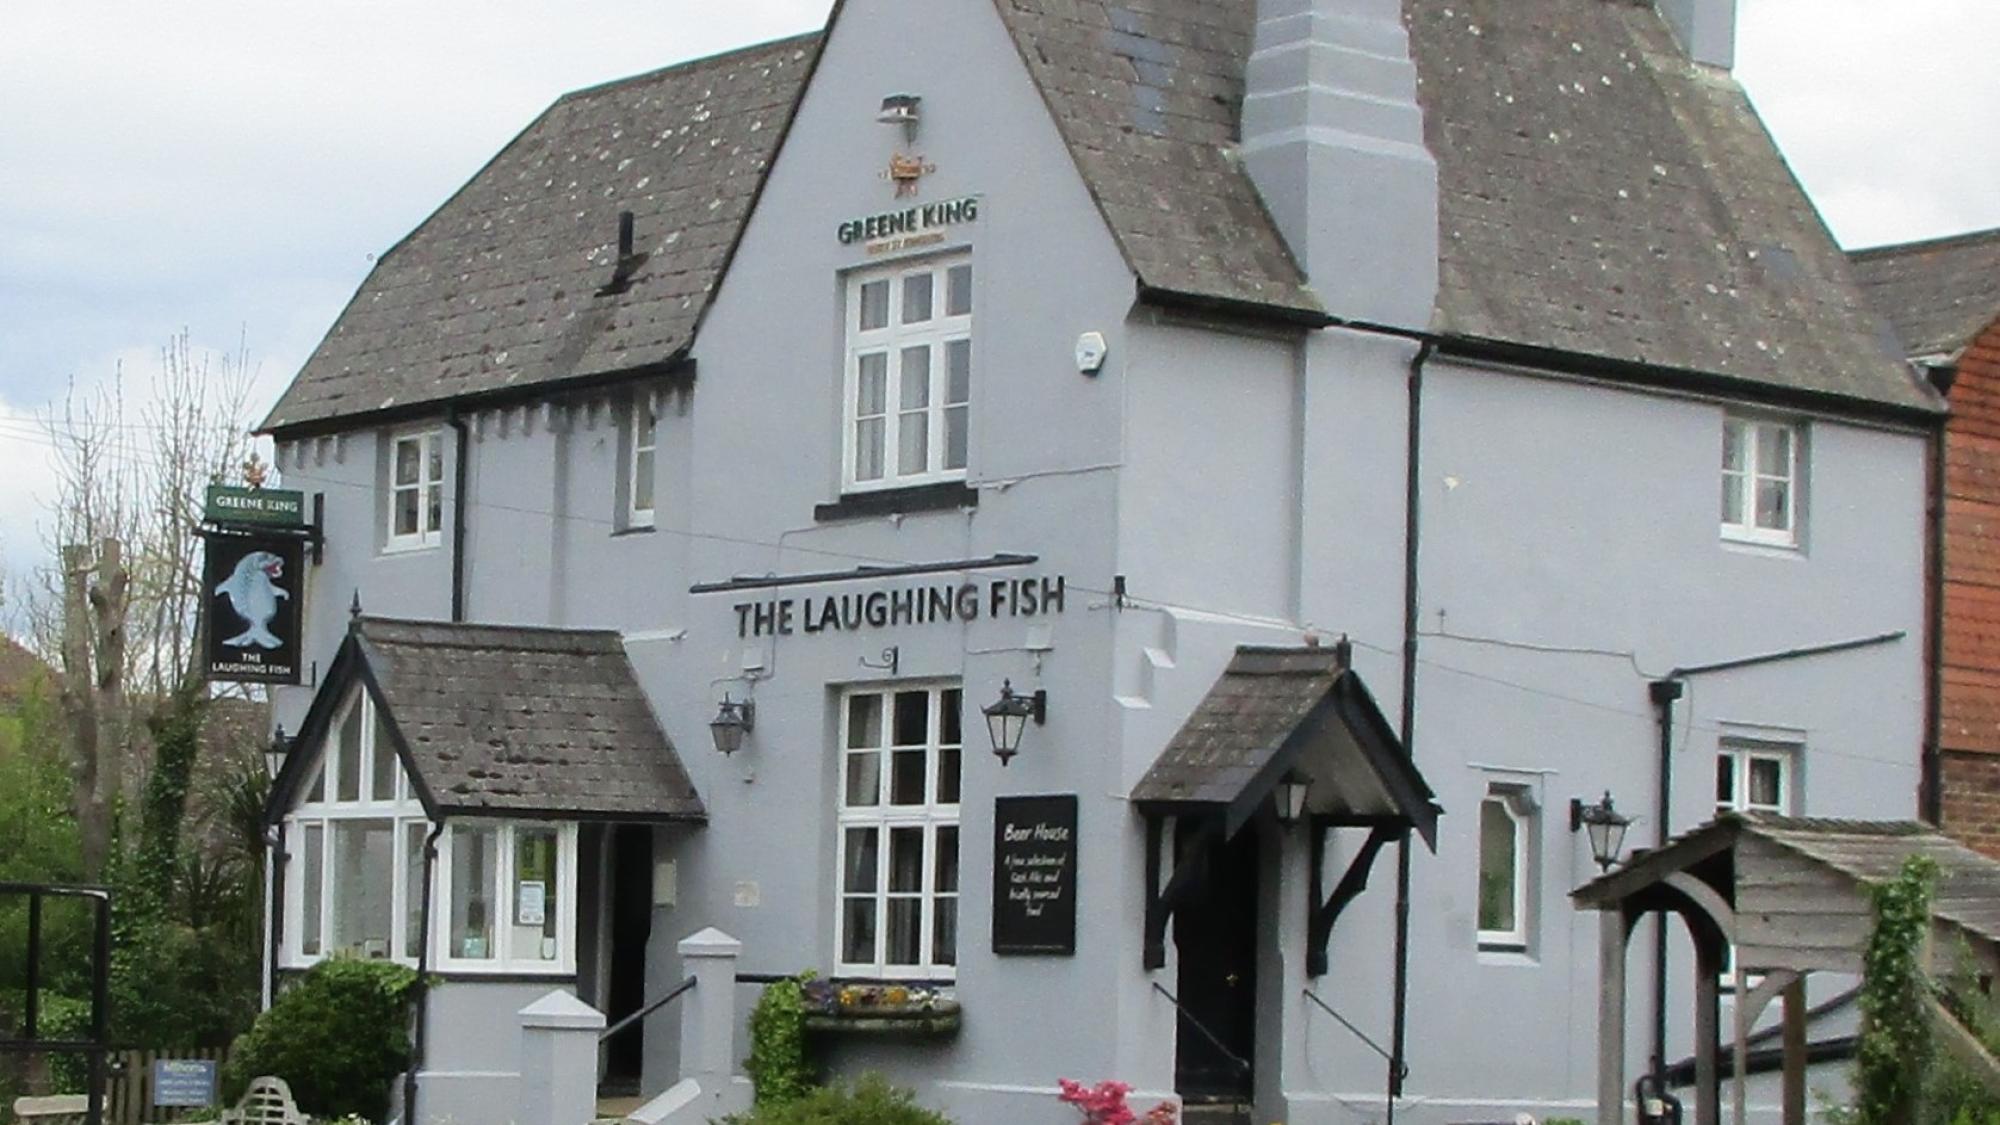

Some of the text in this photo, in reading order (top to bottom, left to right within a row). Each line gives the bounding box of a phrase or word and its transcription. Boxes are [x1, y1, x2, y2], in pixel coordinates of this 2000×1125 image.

[838, 209, 917, 244] GREENE
[922, 198, 977, 228] KING
[216, 495, 298, 513] GREENE KING
[734, 576, 1065, 637] THE LAUGHING FISH
[242, 653, 261, 663] THE
[212, 661, 291, 675] LAUGHING FISH
[1005, 822, 1069, 841] Beer House
